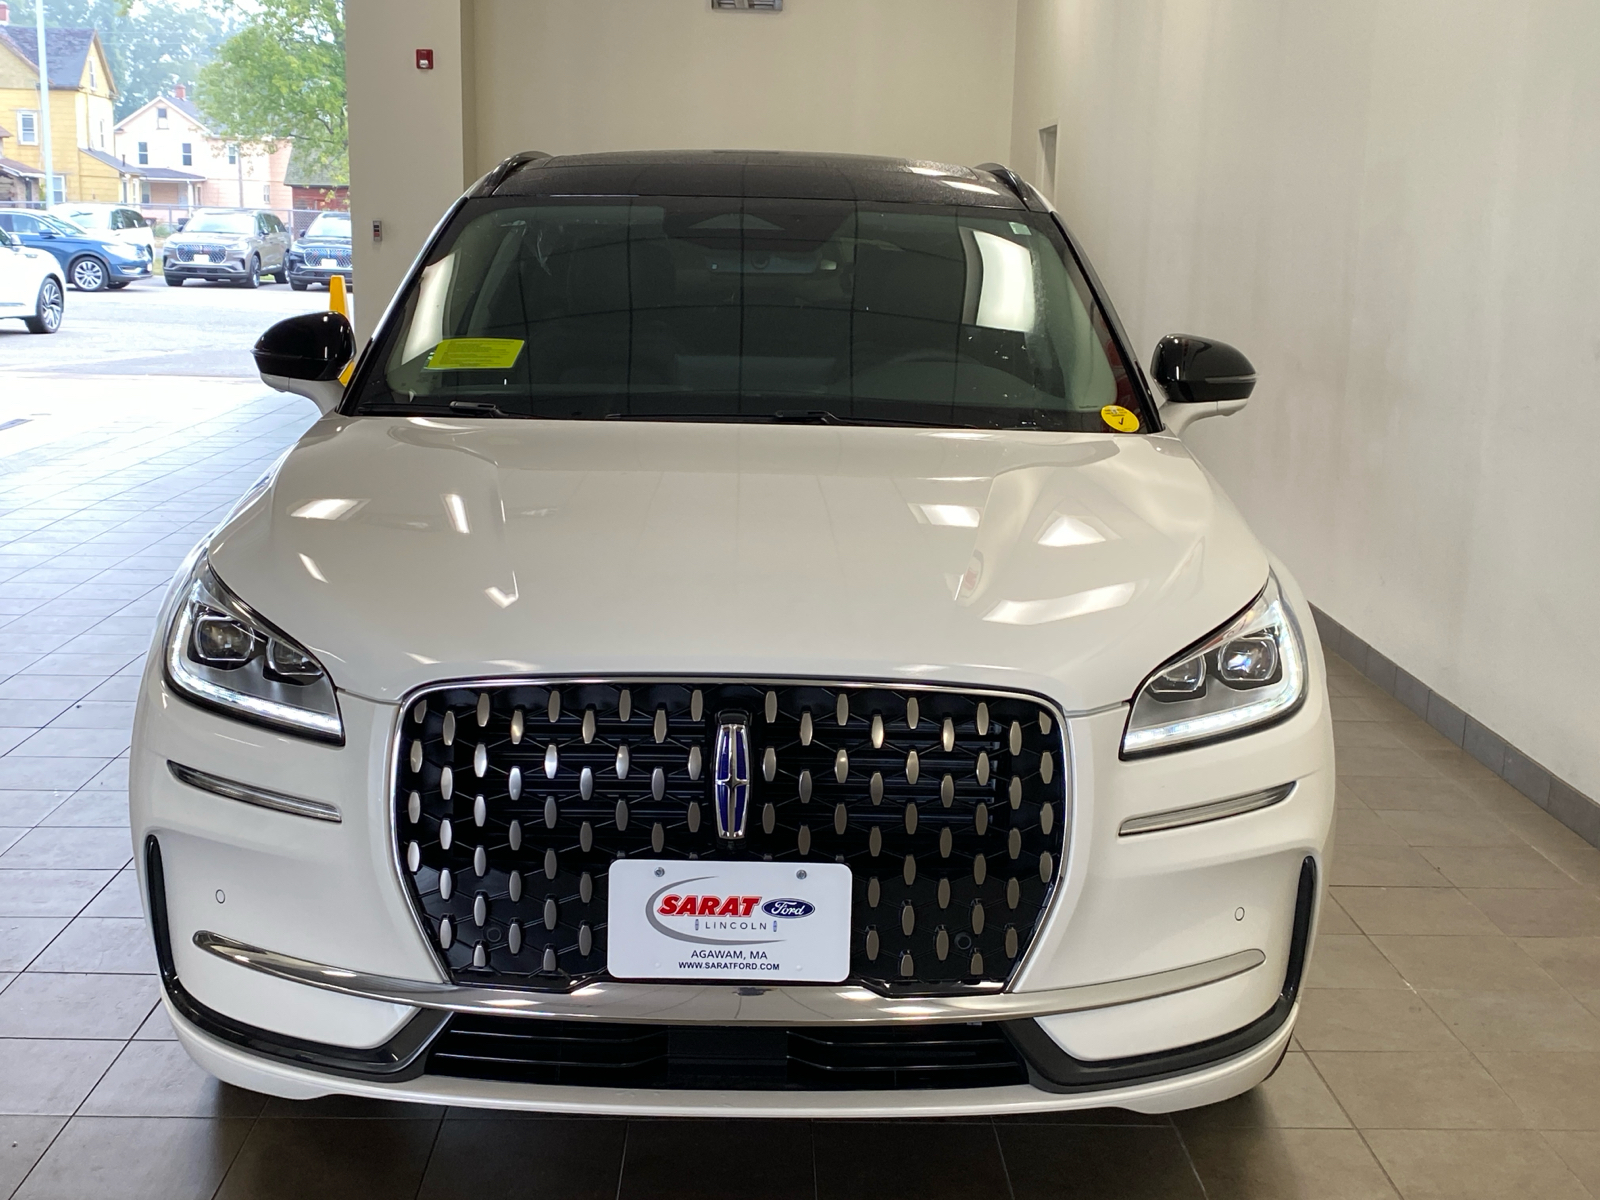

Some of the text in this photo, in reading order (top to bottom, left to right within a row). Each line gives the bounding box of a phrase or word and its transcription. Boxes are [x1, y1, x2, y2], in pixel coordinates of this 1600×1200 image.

[657, 894, 806, 917] SARAT Ford
[705, 921, 767, 930] LINCOLN
[691, 950, 768, 960] AGAWAM, MA
[678, 961, 780, 971] WWW.SARATFORD.COM
